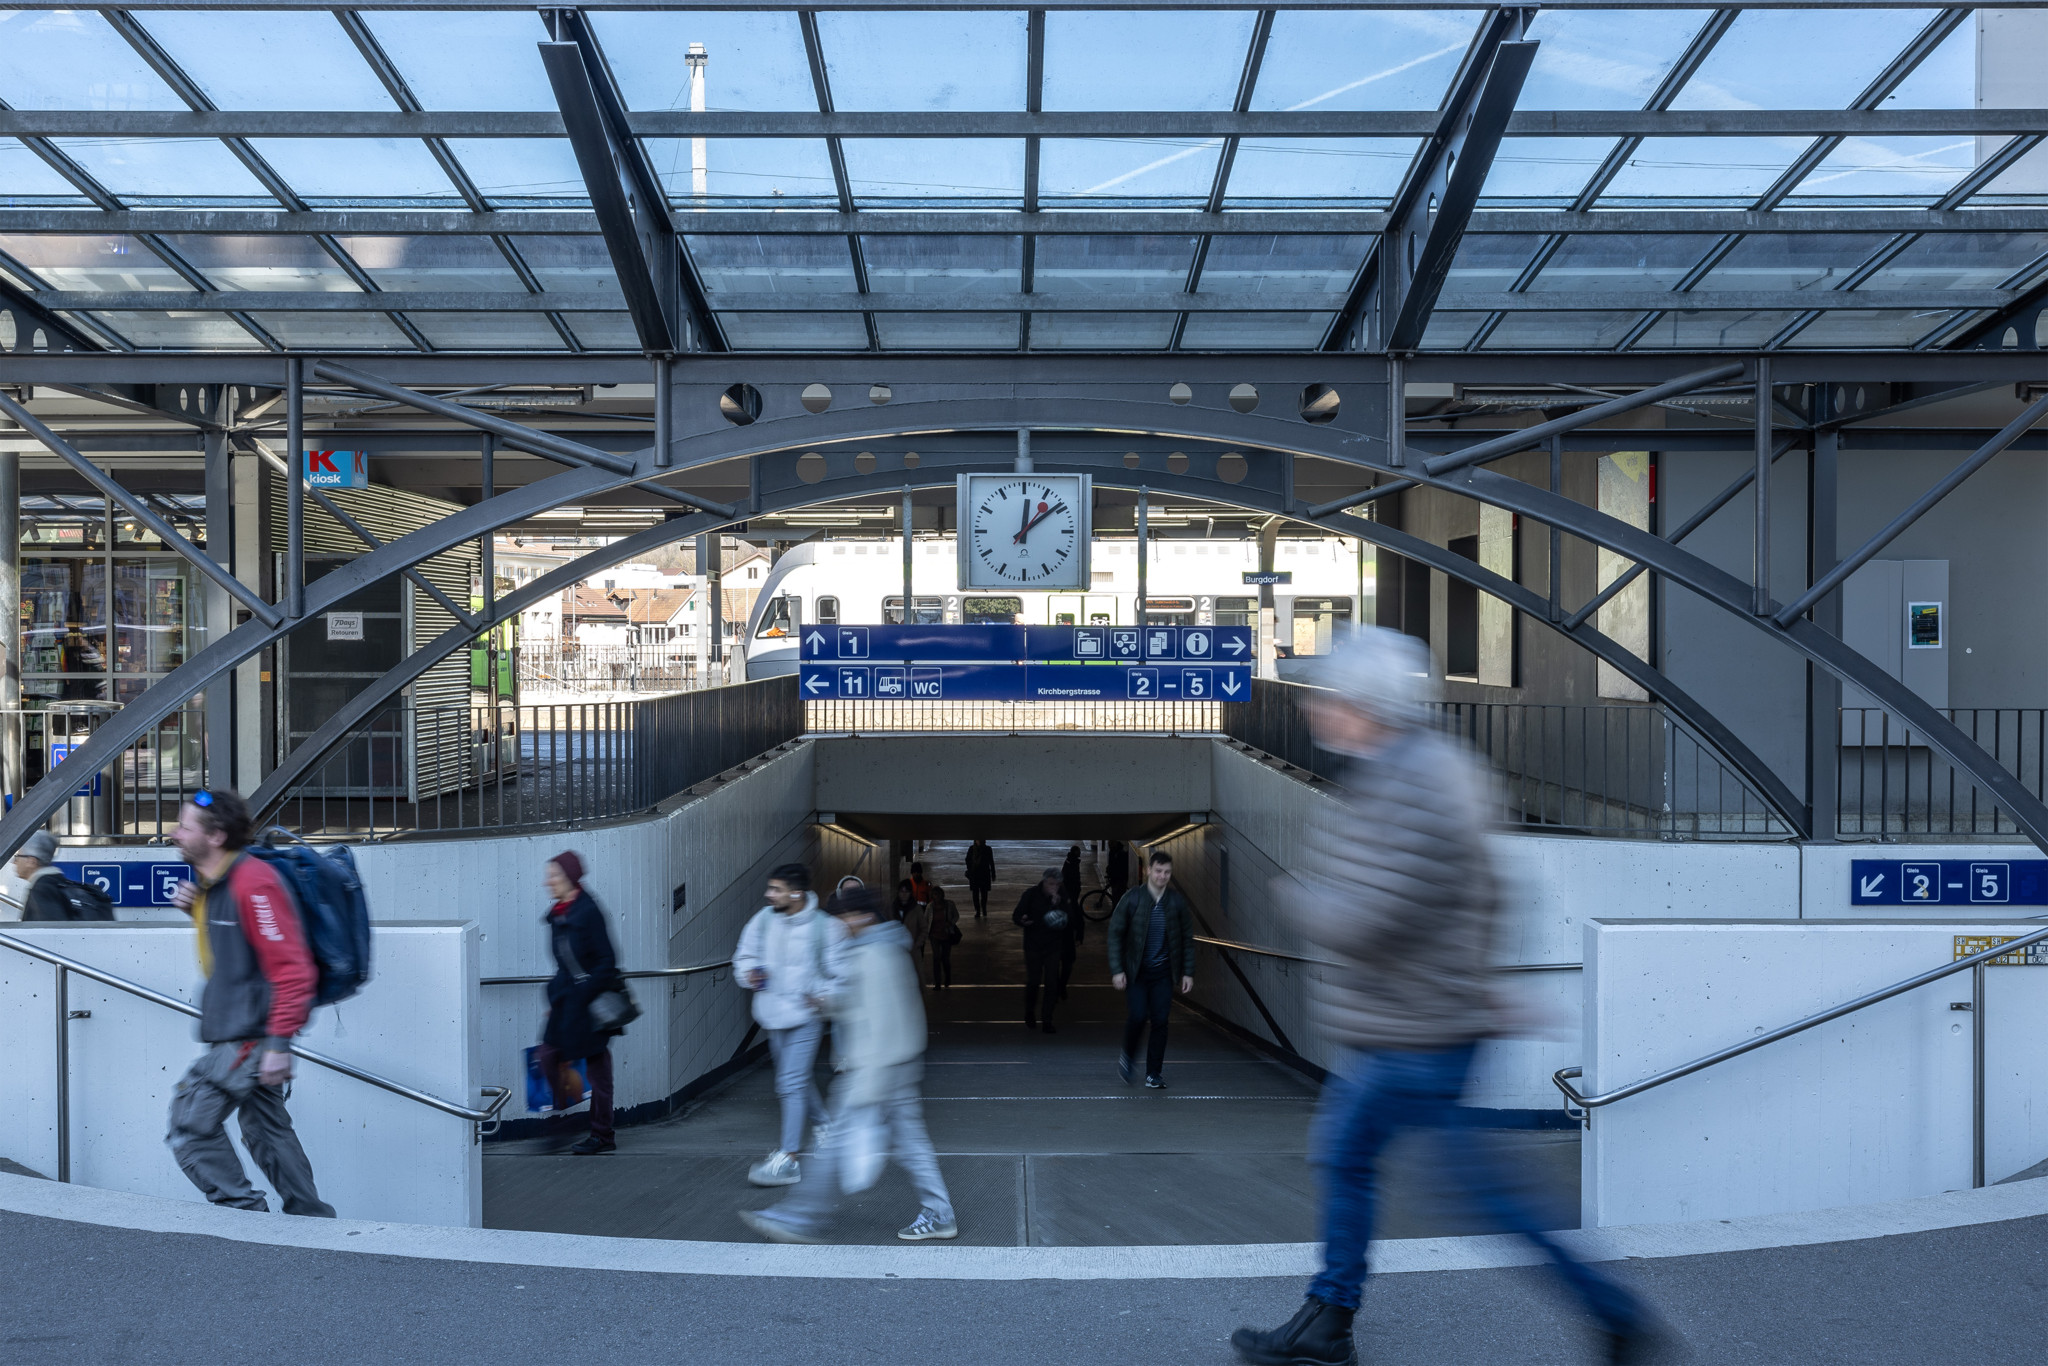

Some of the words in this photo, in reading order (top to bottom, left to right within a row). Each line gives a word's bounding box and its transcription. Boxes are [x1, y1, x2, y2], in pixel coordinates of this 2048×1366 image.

[309, 450, 340, 472] K
[354, 450, 364, 474] K
[309, 474, 341, 484] kiosk
[1245, 576, 1278, 584] Burgdorf
[947, 596, 958, 611] 2
[1199, 596, 1210, 611] 2
[334, 620, 355, 628] 7Days
[848, 636, 857, 655] 1
[844, 676, 863, 695] 11
[913, 682, 940, 695] WC
[1037, 687, 1101, 696] Kirchbergstrasse
[1136, 677, 1150, 696] 2
[1190, 677, 1204, 696] 5
[162, 876, 179, 900] 5
[1913, 875, 1929, 897] 2
[1981, 875, 1998, 898] 5
